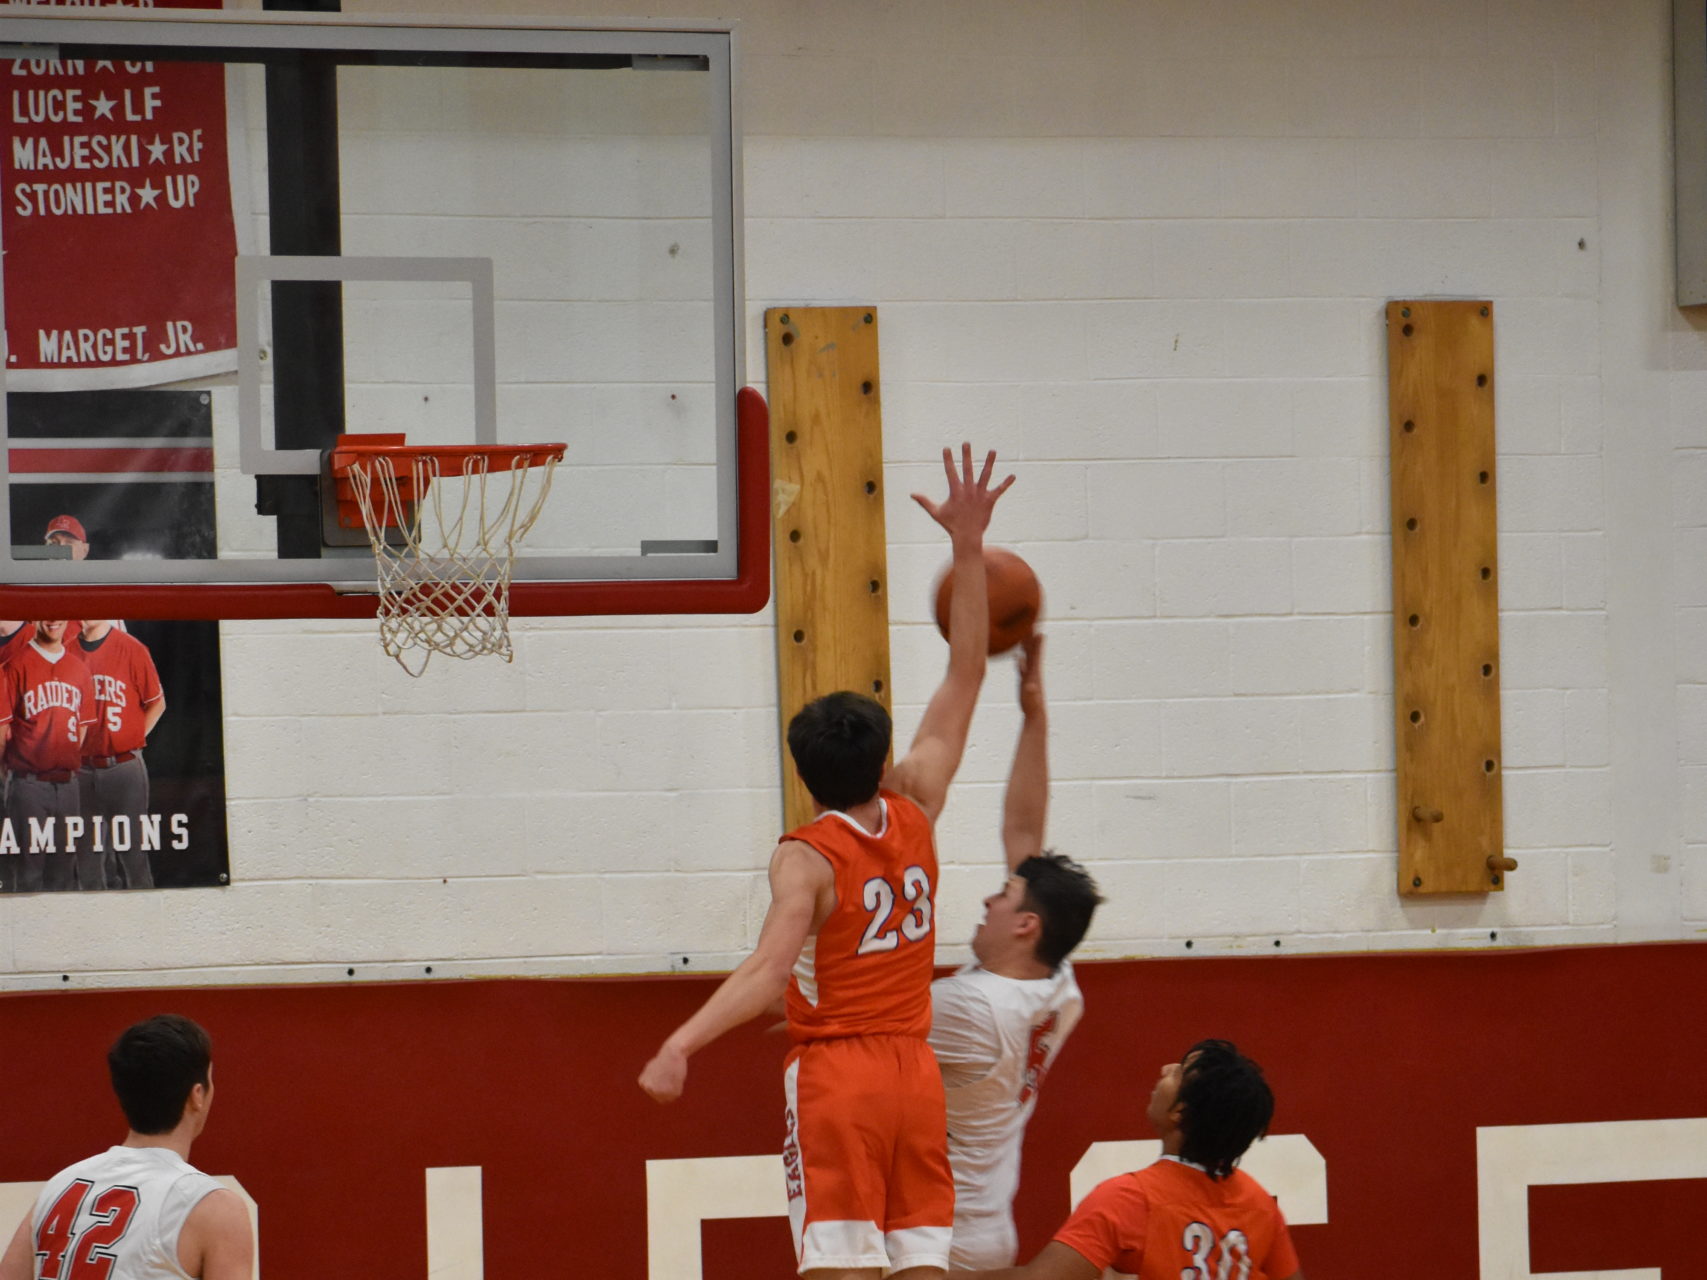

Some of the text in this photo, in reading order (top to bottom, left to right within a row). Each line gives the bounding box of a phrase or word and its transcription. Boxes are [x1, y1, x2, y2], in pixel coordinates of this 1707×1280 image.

[12, 86, 161, 123] LUCE LF
[12, 129, 203, 171] MAJESKI RF
[15, 175, 200, 217] STONIER UP
[159, 321, 204, 355] JR.
[107, 706, 122, 732] 5
[0, 813, 189, 855] AMPIONS
[857, 864, 932, 955] 23
